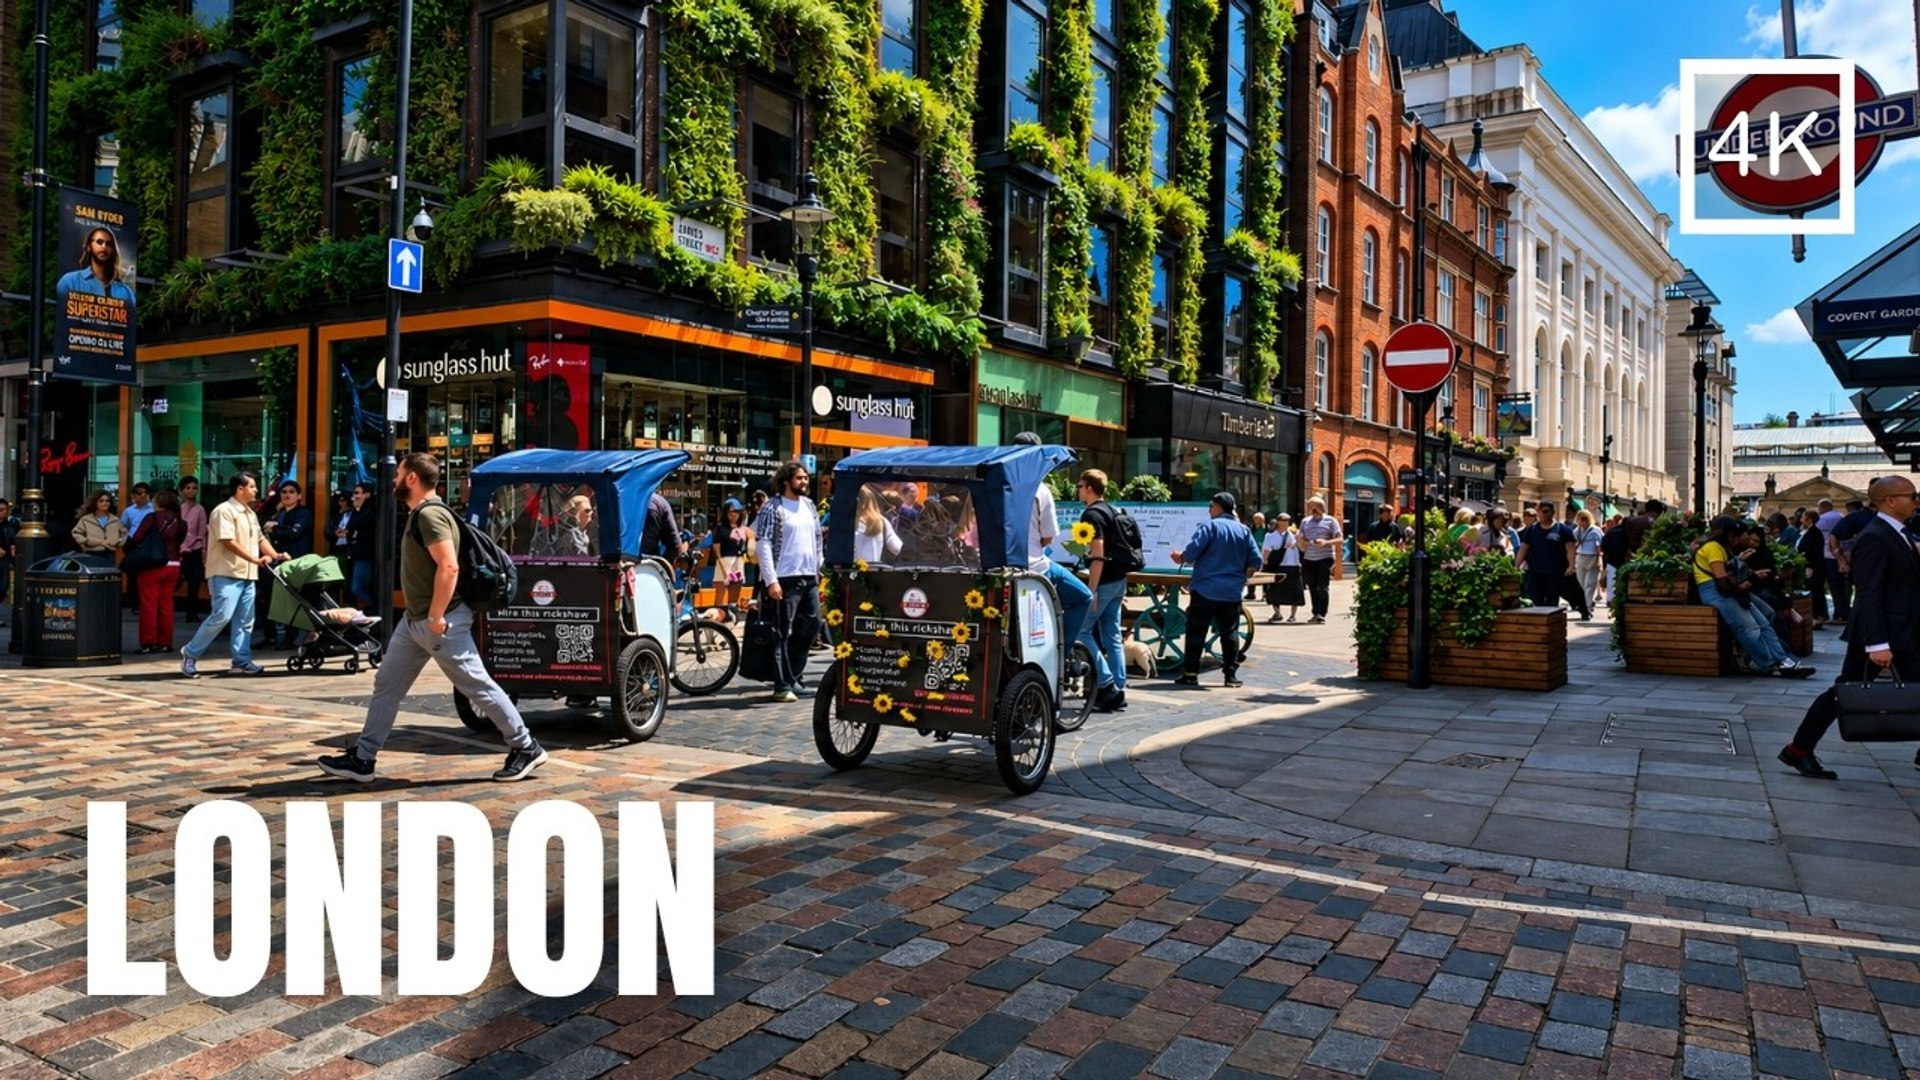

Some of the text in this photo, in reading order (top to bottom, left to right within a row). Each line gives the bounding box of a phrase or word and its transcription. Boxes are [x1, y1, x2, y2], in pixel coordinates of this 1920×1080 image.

[1695, 105, 1905, 158] UNDEGROND
[1827, 310, 1877, 323] COVENT
[403, 351, 478, 384] sunglass
[481, 347, 512, 374] hut
[836, 393, 915, 420] sunglass hut
[890, 622, 910, 633] this
